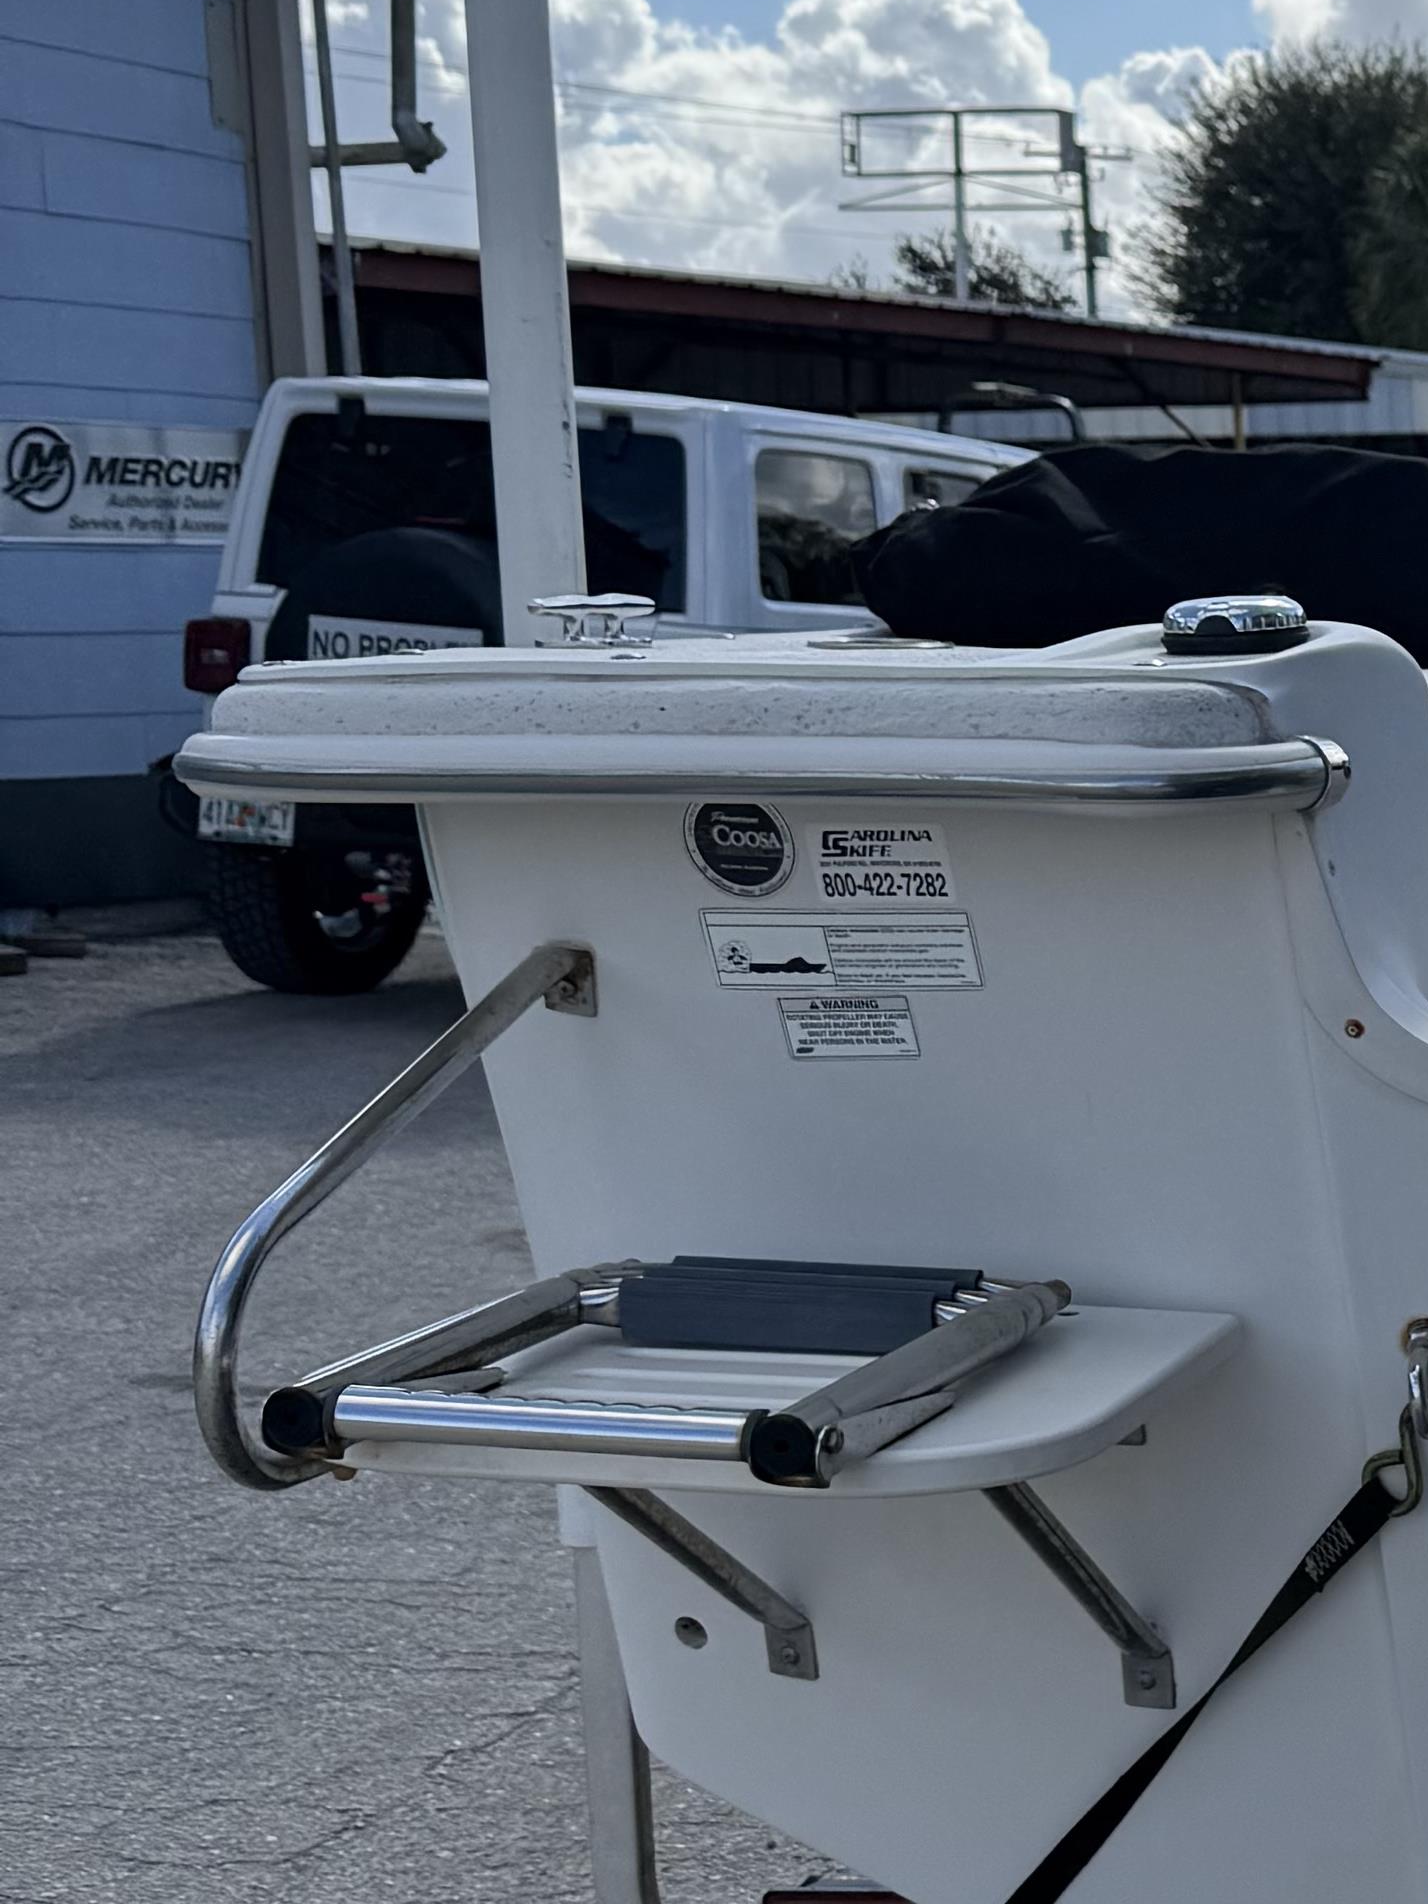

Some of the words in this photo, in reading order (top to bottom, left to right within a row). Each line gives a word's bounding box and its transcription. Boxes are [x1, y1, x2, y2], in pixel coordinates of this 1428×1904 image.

[313, 630, 349, 659] NO
[822, 873, 949, 897] 800-422-7282
[821, 999, 879, 1009] WARNING
